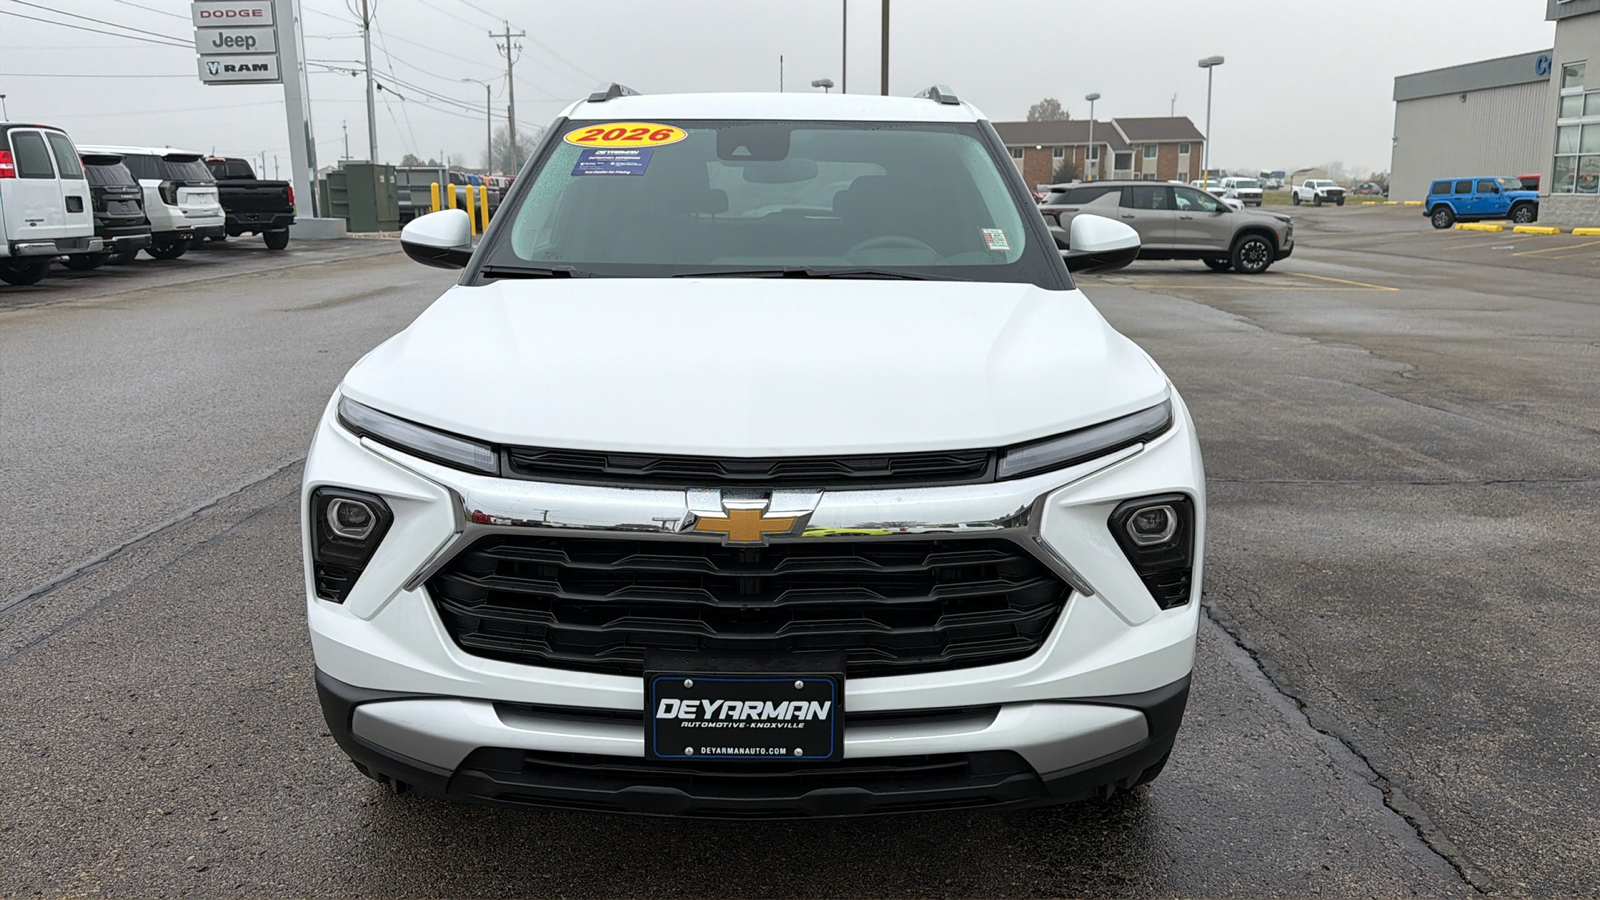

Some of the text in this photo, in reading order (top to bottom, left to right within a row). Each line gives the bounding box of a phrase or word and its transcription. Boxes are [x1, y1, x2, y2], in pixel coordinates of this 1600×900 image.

[200, 9, 263, 18] DODGE
[212, 32, 257, 50] Jeep
[223, 63, 269, 72] RAM
[575, 128, 675, 142] 2026
[656, 698, 832, 720] DEYARMAN
[700, 746, 787, 755] DEYARMANAUTO.COM
